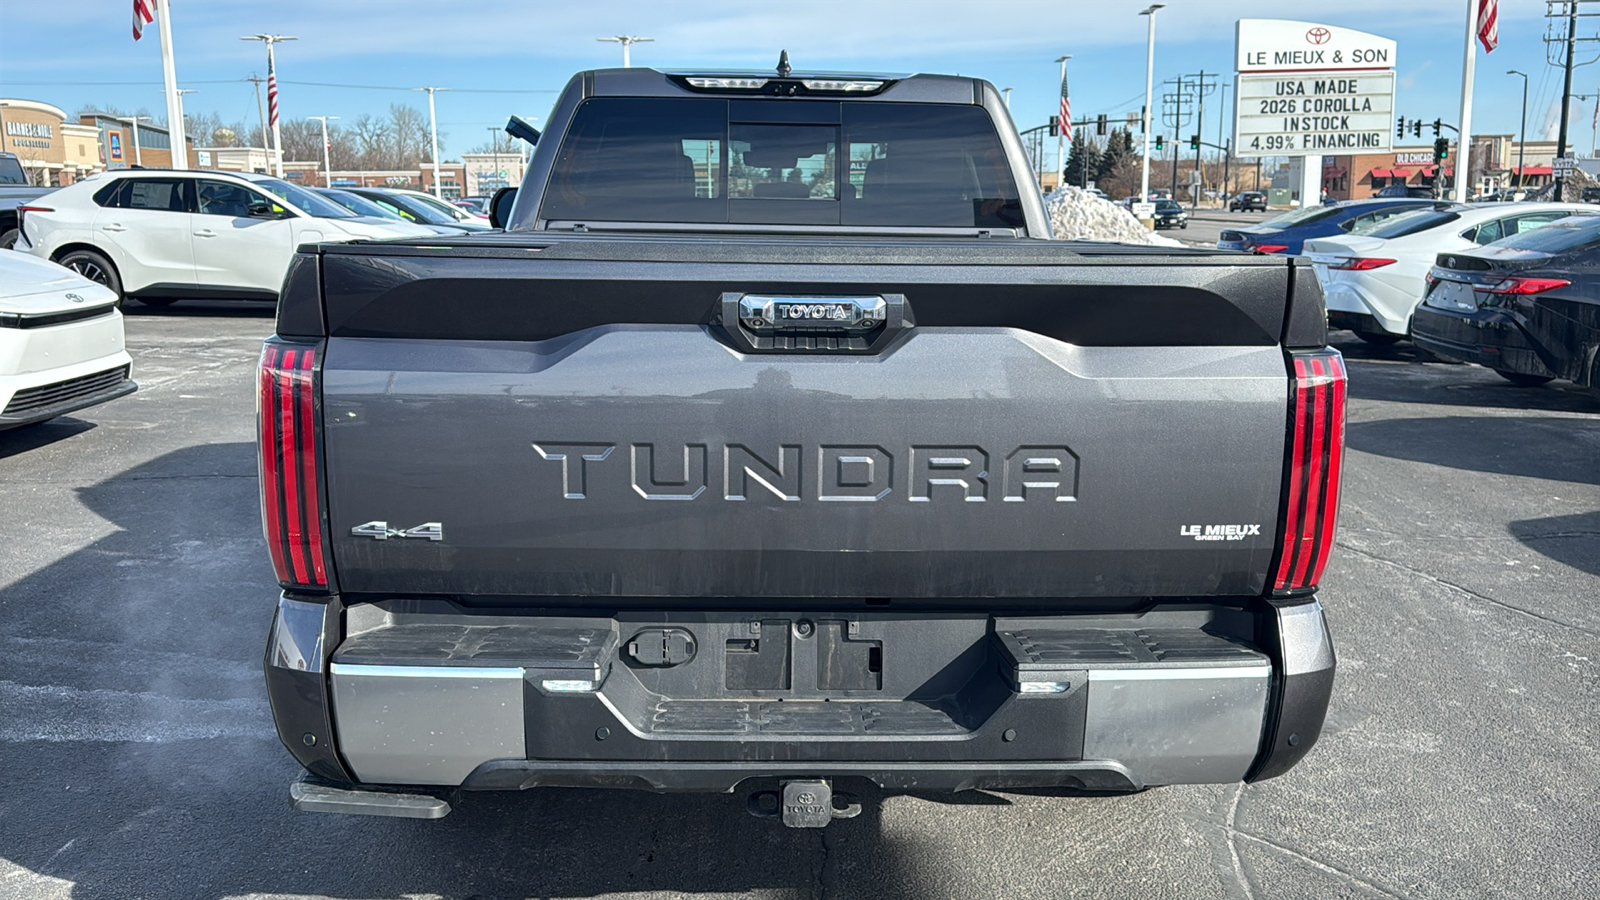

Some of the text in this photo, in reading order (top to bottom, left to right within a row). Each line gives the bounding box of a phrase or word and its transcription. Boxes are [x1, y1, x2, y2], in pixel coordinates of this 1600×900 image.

[1247, 49, 1388, 65] LE MIEUX & SON
[1276, 79, 1358, 96] USA MADE
[1260, 97, 1372, 114] 2026 COROLLA
[1250, 132, 1380, 150] 4.99% FINANCING
[1396, 153, 1409, 163] OLD
[779, 304, 847, 319] TOYOTA
[532, 441, 1080, 502] TUNDRA
[1180, 524, 1261, 536] LE MIEUX
[786, 804, 825, 813] TOYOTA
